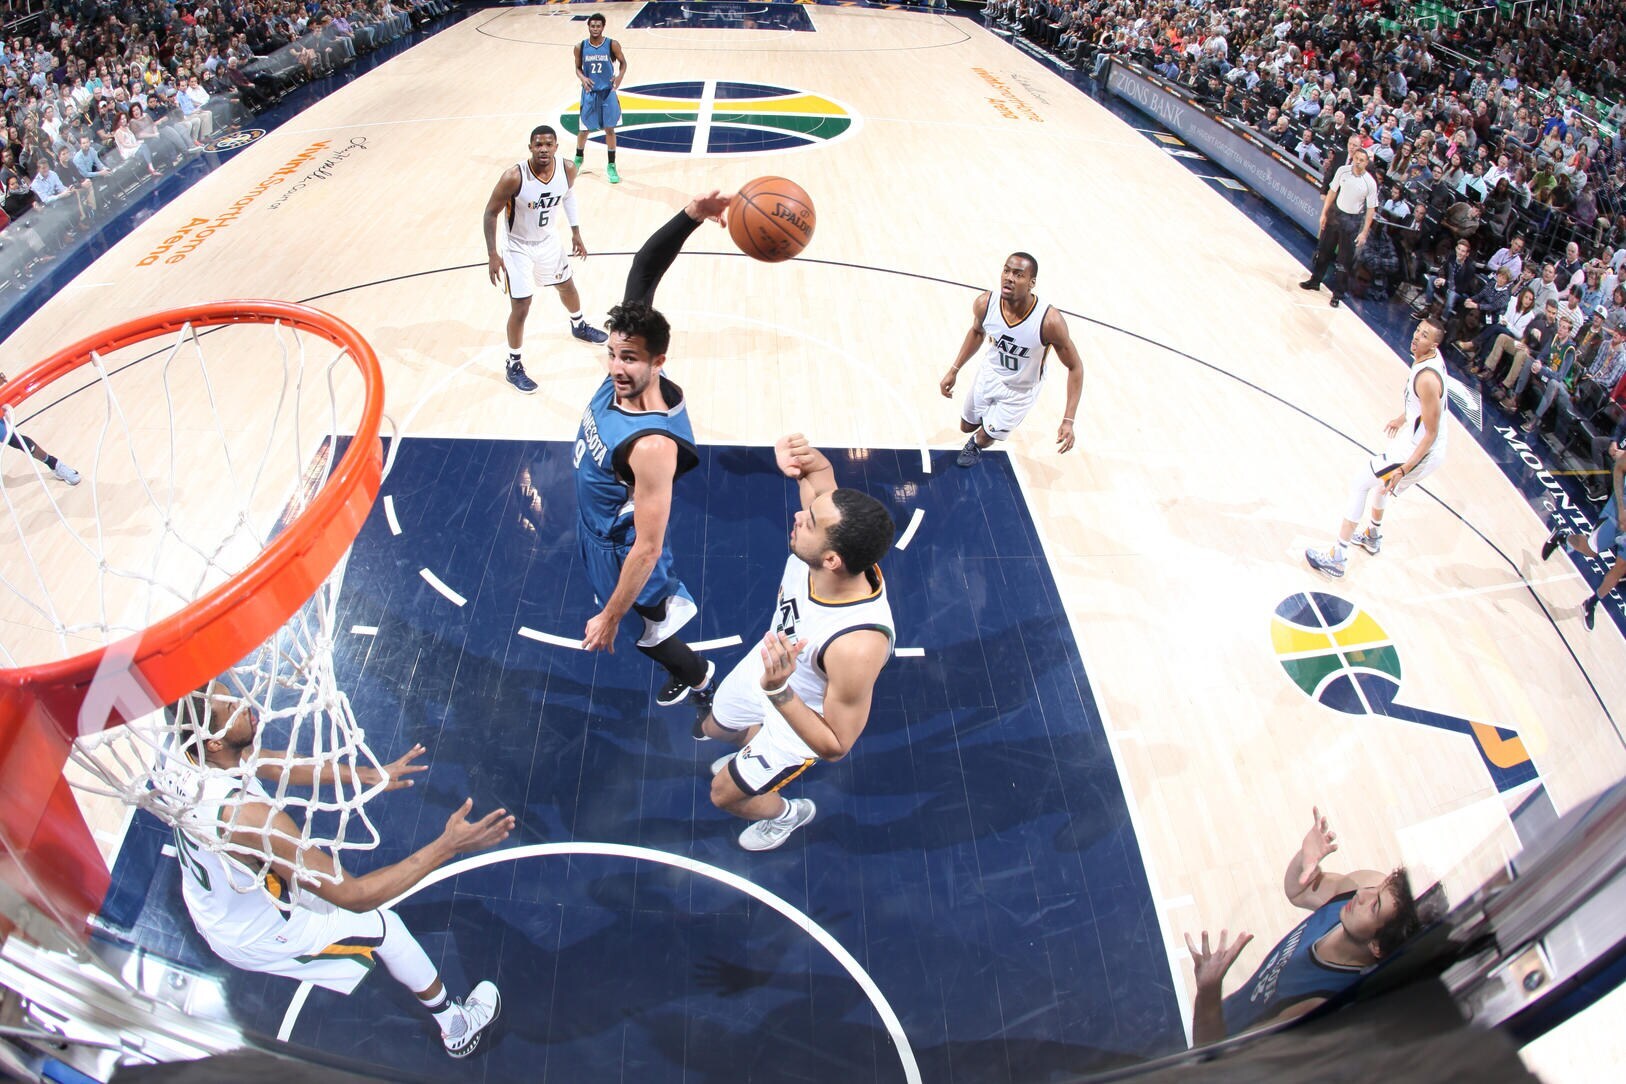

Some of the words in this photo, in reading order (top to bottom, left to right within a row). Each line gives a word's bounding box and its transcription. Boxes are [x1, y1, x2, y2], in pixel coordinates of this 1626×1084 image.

[591, 63, 602, 74] 22
[1117, 73, 1149, 105] ZIONS
[1150, 93, 1184, 128] BANK
[538, 210, 550, 227] 6
[136, 216, 210, 267] Arena
[999, 351, 1019, 371] 10
[573, 438, 587, 469] 9
